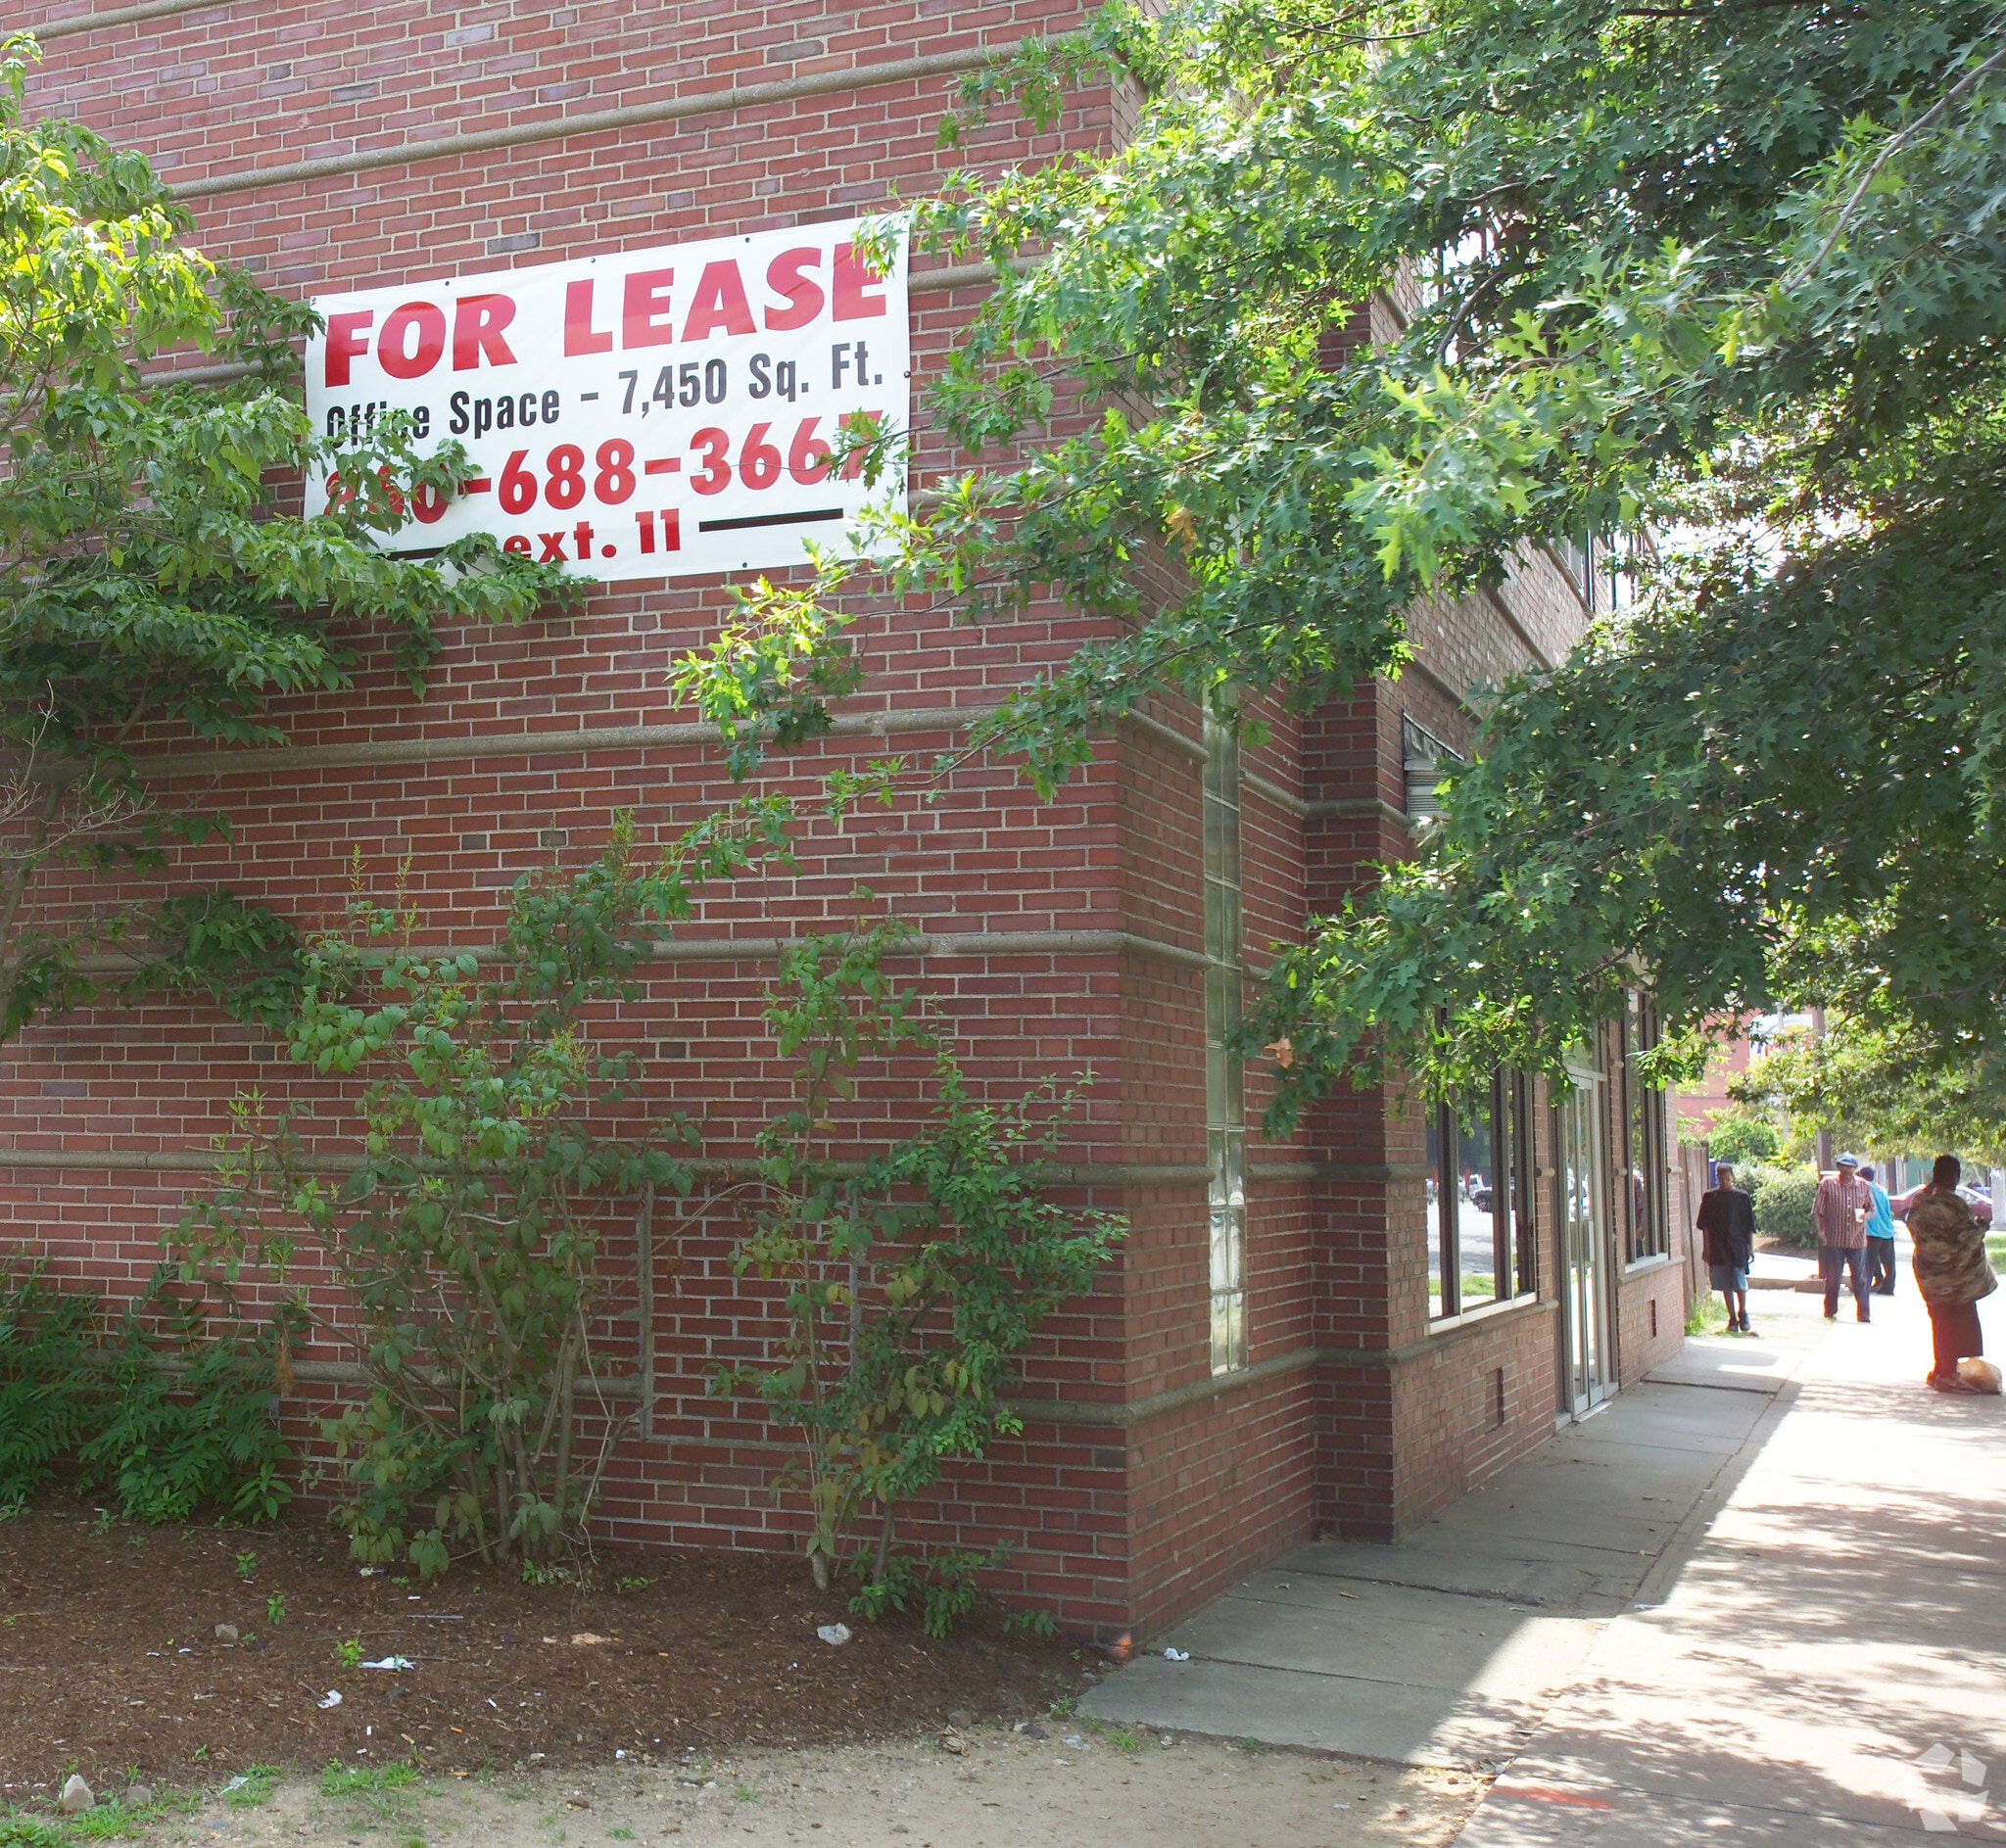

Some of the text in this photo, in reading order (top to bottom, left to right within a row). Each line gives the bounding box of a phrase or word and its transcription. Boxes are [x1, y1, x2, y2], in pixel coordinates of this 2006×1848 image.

[325, 241, 886, 387] FOR LEASE
[326, 401, 430, 449] Offe
[450, 390, 560, 440] Space
[618, 358, 727, 418] 7,450
[749, 353, 809, 403] Sq.
[832, 341, 883, 390] Ft.
[502, 507, 681, 565] ext. 11
